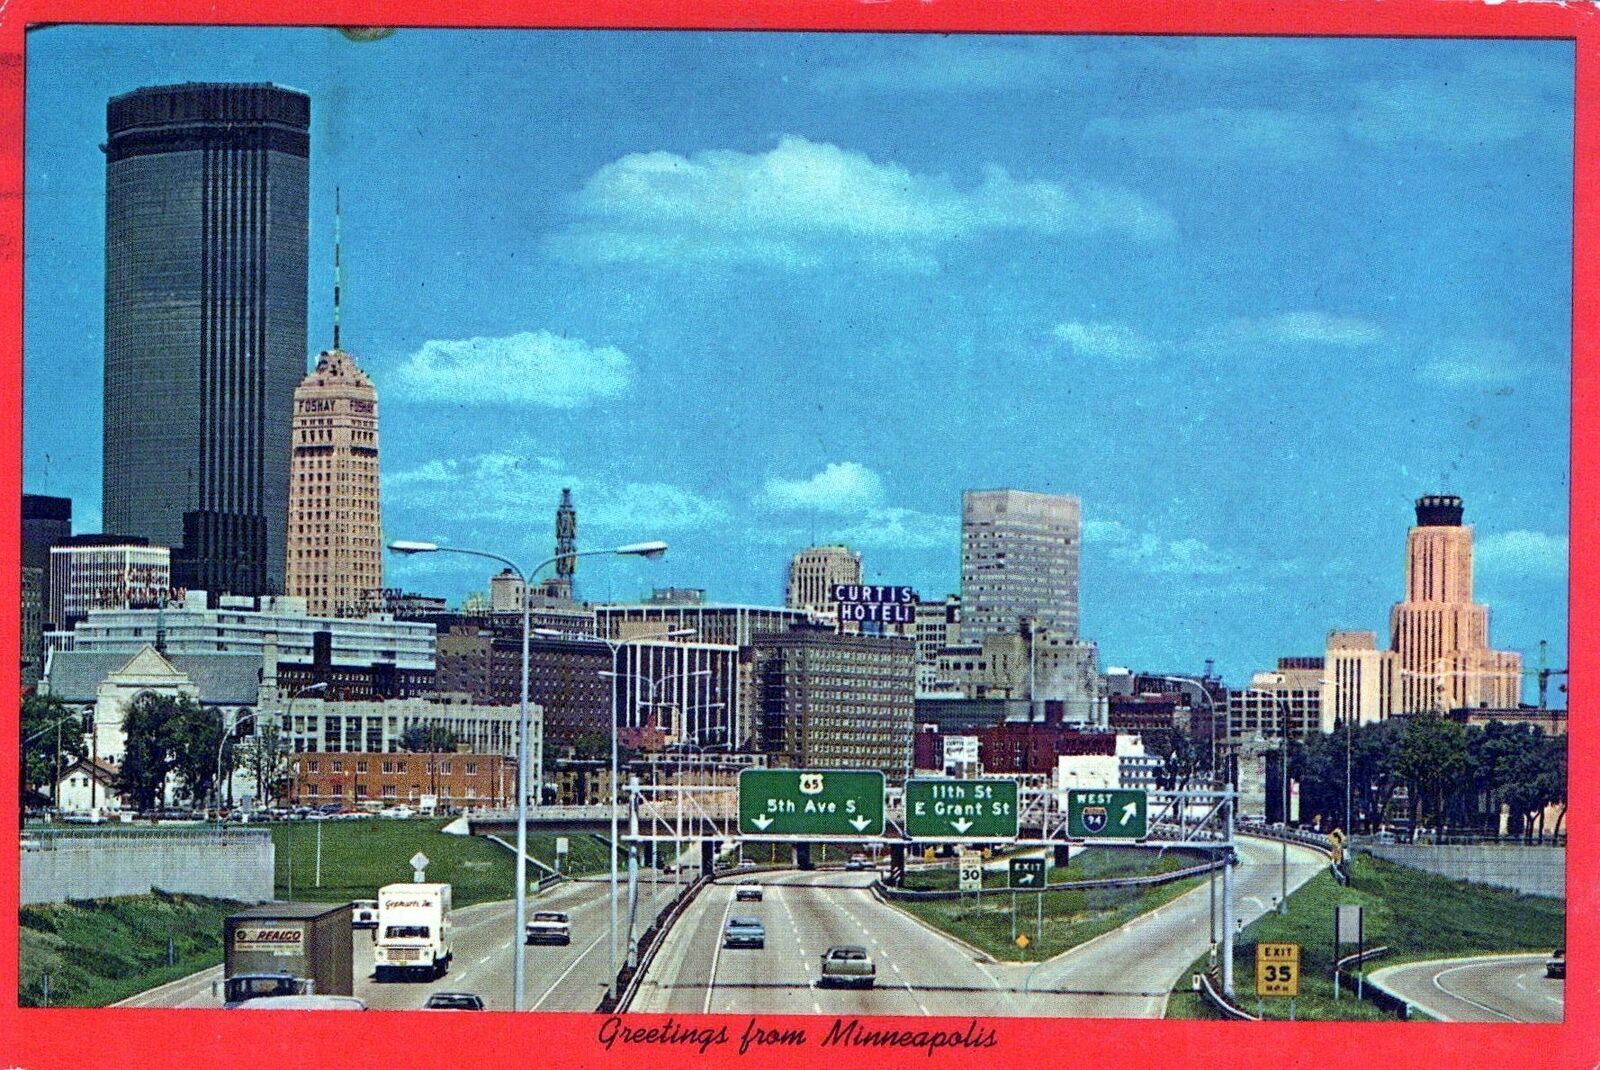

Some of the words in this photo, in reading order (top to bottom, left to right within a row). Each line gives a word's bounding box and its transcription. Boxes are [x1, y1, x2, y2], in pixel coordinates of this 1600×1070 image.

[299, 399, 335, 412] FOSHAY
[836, 586, 911, 602] CURTIS
[804, 780, 819, 789] 65
[932, 785, 965, 799] 11th
[974, 785, 993, 798] St
[1077, 794, 1113, 804] WEST
[767, 799, 795, 812] 5th
[804, 800, 836, 813] Ave
[846, 800, 856, 813] S
[915, 802, 926, 815] E
[934, 802, 982, 815] Grant
[992, 802, 1010, 815] St
[1088, 816, 1101, 824] 94
[1014, 863, 1041, 871] EXIT
[962, 870, 980, 880] 30
[1264, 947, 1292, 957] EXIT
[1264, 965, 1292, 982] 35
